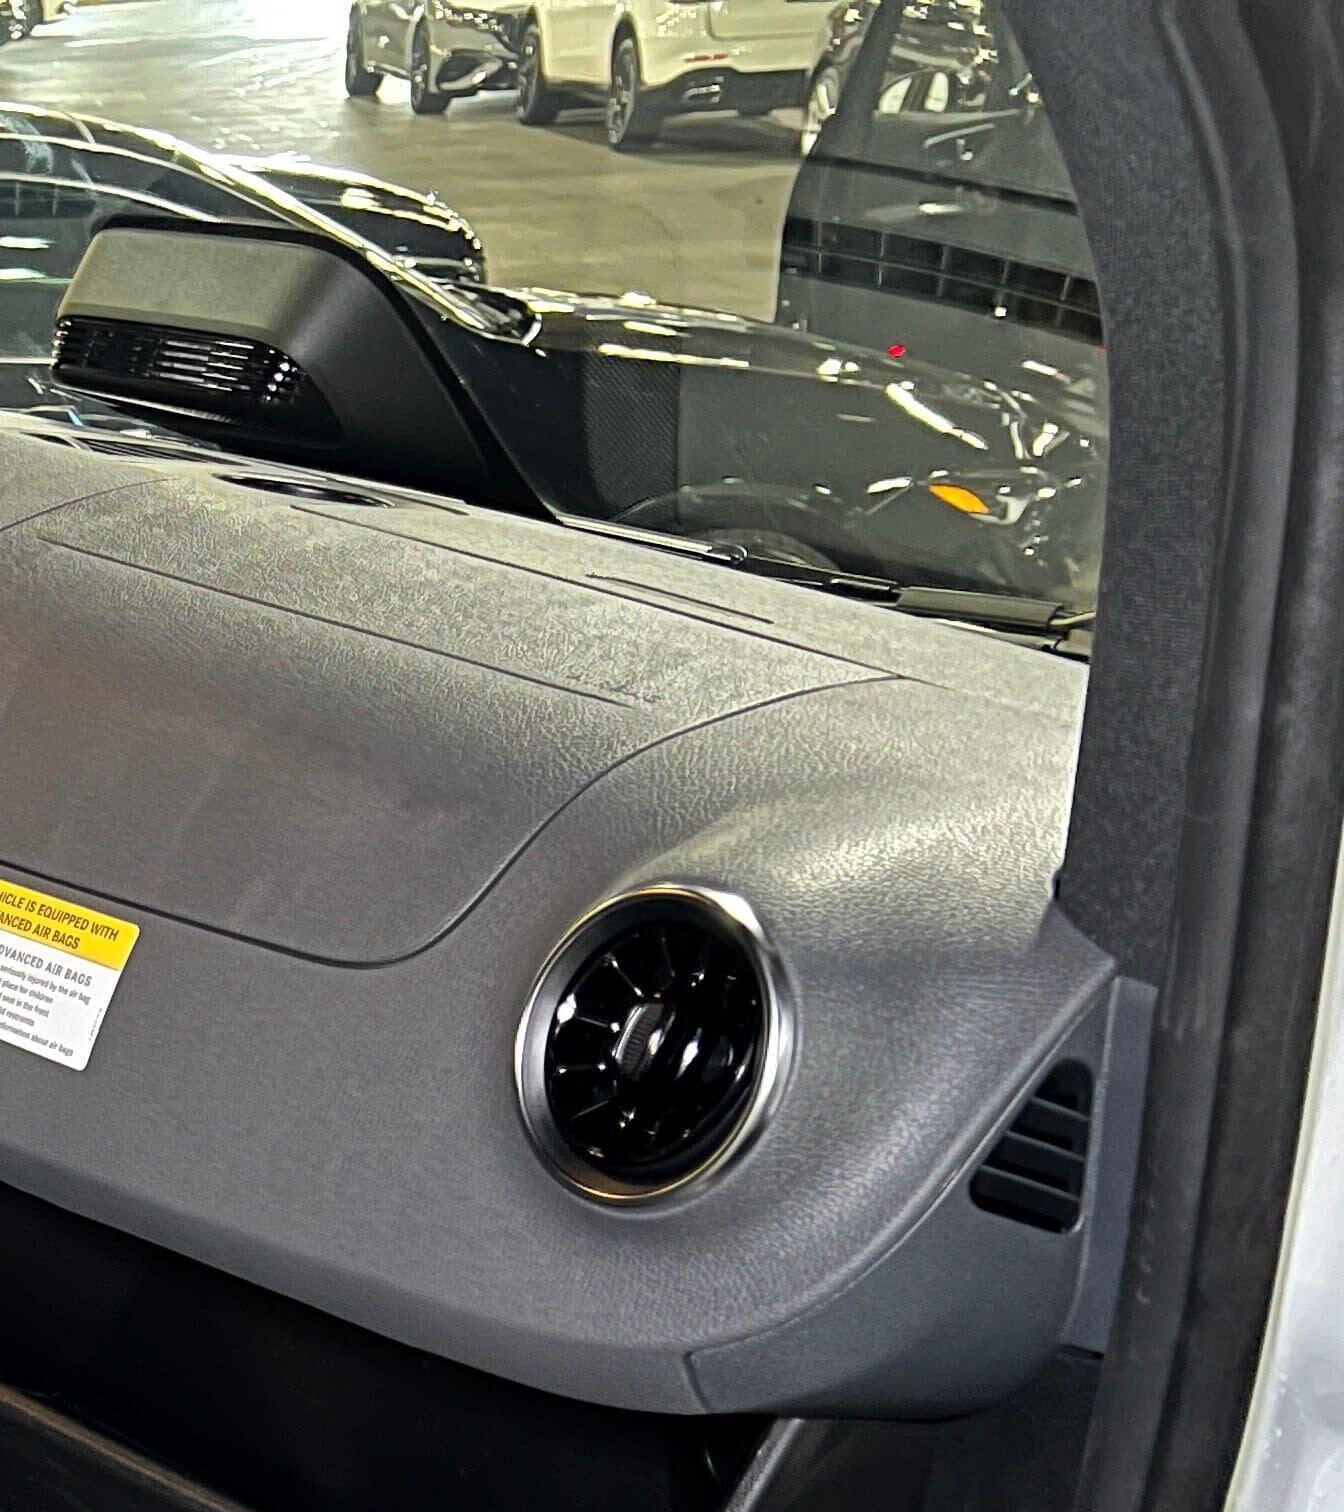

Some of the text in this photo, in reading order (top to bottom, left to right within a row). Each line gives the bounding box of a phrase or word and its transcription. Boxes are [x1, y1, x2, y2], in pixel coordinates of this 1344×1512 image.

[24, 899, 36, 912] IS
[36, 903, 89, 930] EQUIPPED
[90, 921, 119, 941] WITH
[31, 923, 51, 939] AIR
[51, 929, 80, 949] BAGS
[44, 961, 63, 976] AIR
[63, 967, 92, 986] BAGS
[57, 984, 68, 995] the
